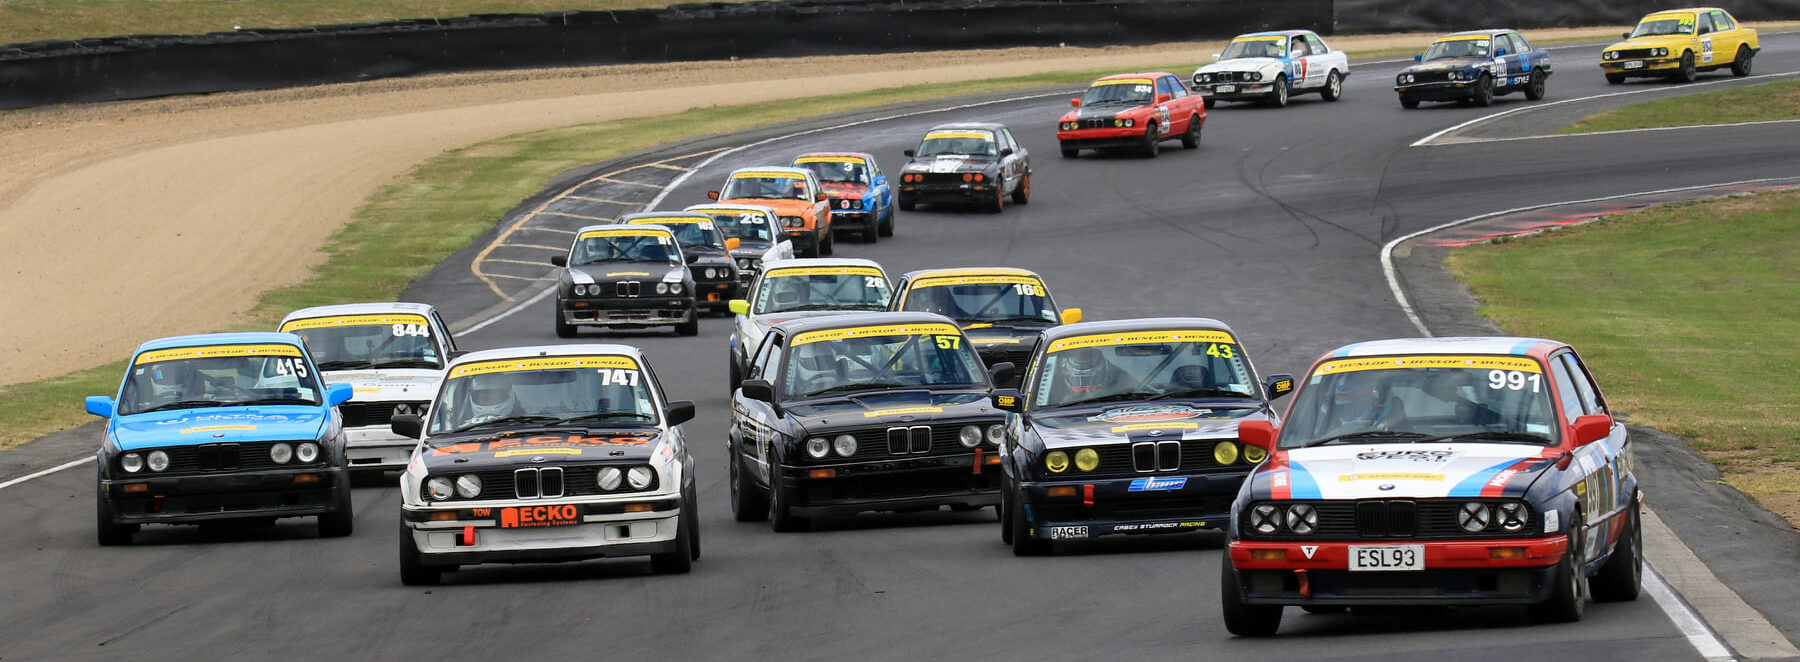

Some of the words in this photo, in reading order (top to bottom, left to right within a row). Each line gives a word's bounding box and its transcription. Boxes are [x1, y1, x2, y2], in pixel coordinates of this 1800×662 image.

[843, 162, 854, 172] 3
[740, 212, 765, 225] 26
[864, 276, 886, 288] 28
[1013, 283, 1046, 297] 166
[391, 323, 430, 338] 844
[806, 331, 844, 340] DUNLOP
[935, 335, 961, 350] 57
[1068, 338, 1111, 346] DUNLOP
[1206, 343, 1233, 359] 43
[276, 357, 308, 379] 415
[470, 363, 513, 372] DUNLOP
[1339, 360, 1390, 368] DUNLOP
[597, 368, 639, 387] 747
[1488, 369, 1543, 394] 991
[472, 508, 492, 517] TOW
[520, 504, 578, 522] ECKO
[1051, 526, 1088, 537] RACER
[1306, 546, 1314, 555] T
[1357, 549, 1415, 568] ESL93
